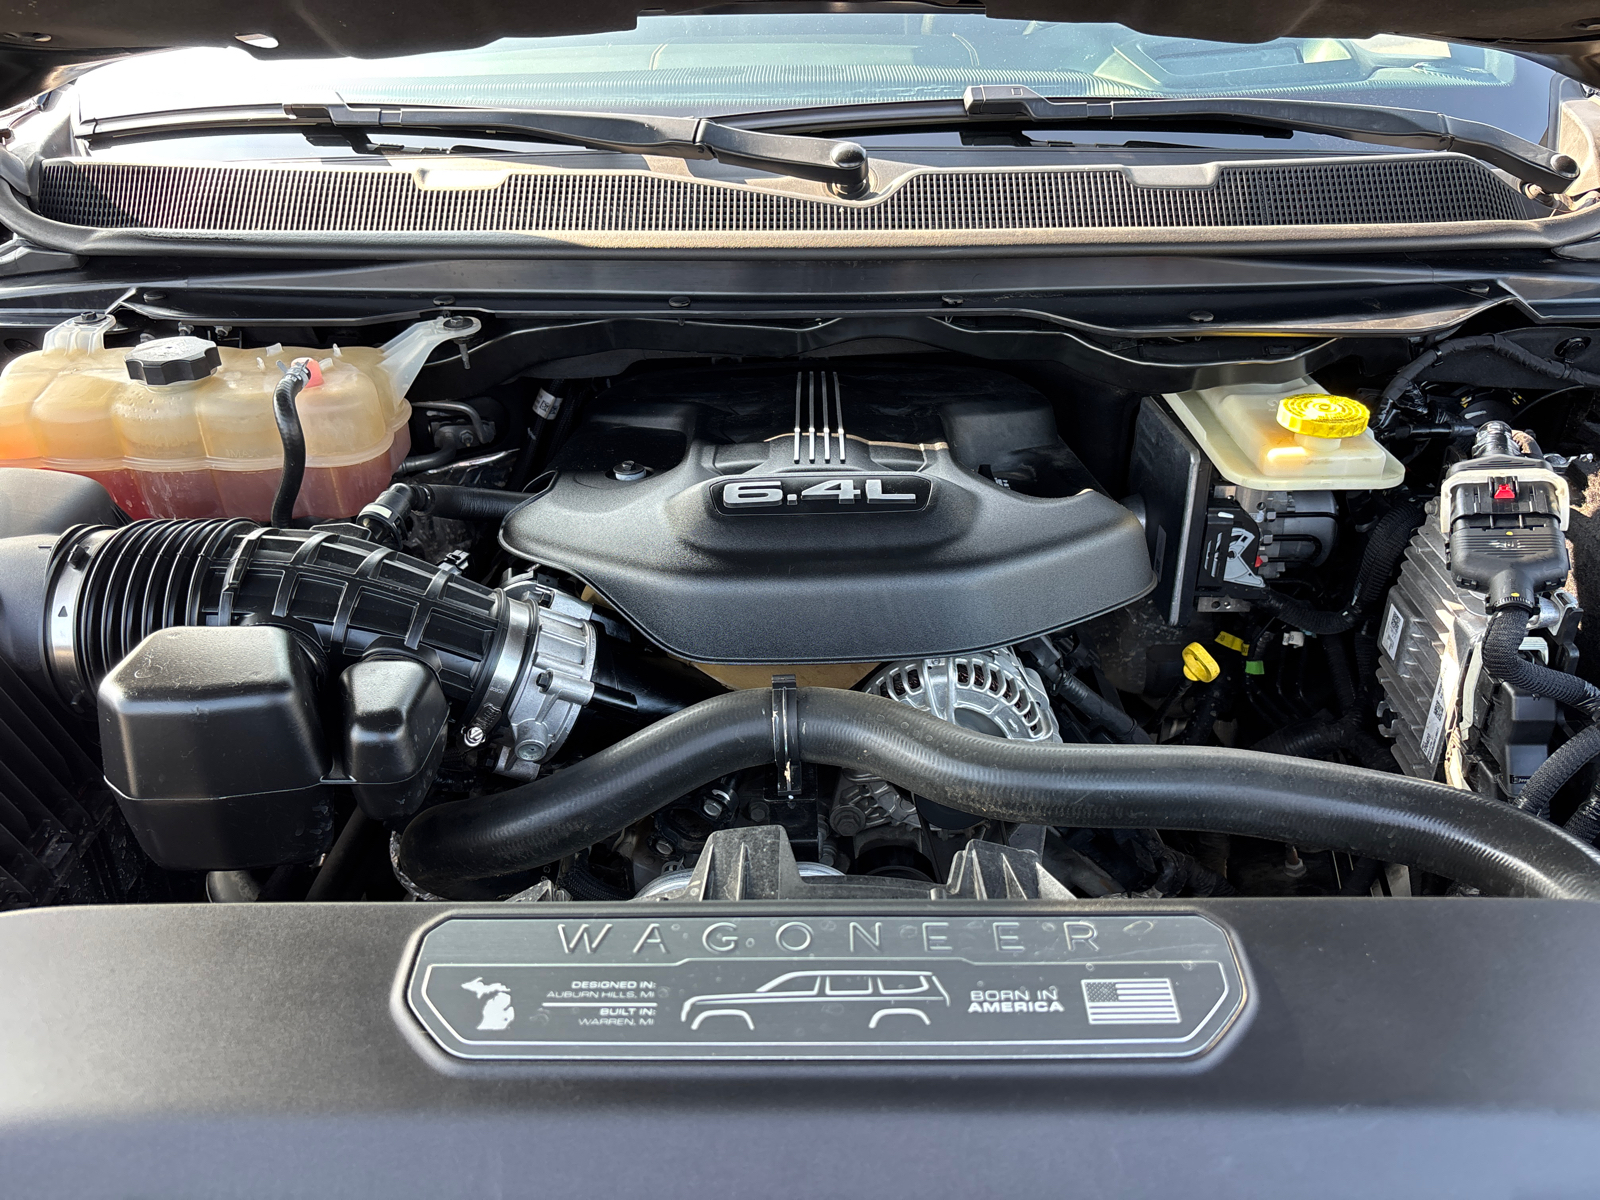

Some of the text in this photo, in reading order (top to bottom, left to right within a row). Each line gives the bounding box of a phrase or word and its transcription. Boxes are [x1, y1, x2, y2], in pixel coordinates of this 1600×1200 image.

[723, 479, 916, 506] 6.4L
[557, 921, 1099, 955] WAGONEER
[571, 980, 657, 989] DESIGNED IN:
[546, 990, 599, 998] AUBURN
[640, 990, 655, 998] MI
[970, 990, 1057, 1001] BORN IN
[600, 1007, 657, 1016] BUILT IN:
[968, 1001, 1065, 1013] AMERICA
[640, 1018, 654, 1026] MI
